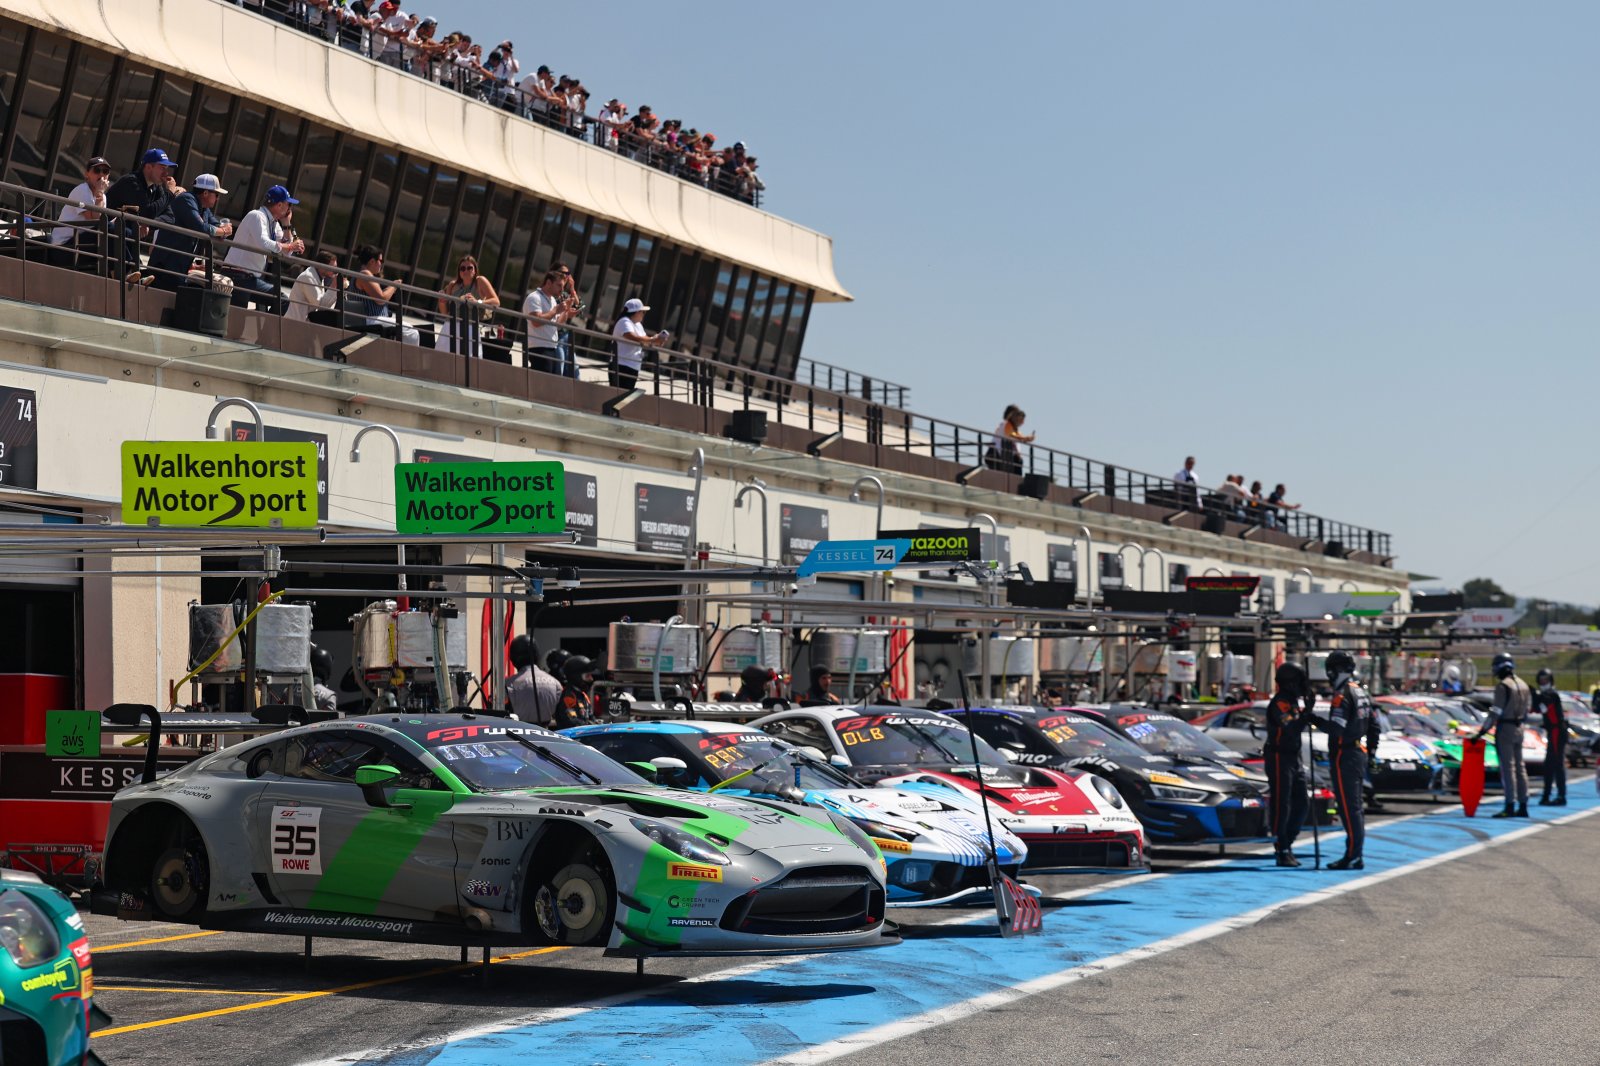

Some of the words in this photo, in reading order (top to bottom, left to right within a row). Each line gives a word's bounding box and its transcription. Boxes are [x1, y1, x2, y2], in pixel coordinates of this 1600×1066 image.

[17, 398, 33, 422] 74
[133, 453, 306, 478] Walkenhorst
[404, 471, 555, 493] Walkenhorst
[586, 481, 596, 499] 66
[133, 483, 307, 525] MotorSport
[405, 496, 556, 532] MotorSport
[576, 513, 594, 527] RACING
[910, 536, 968, 550] razoon
[817, 551, 868, 561] KESSEL
[875, 548, 894, 561] 74
[62, 735, 84, 747] aws
[273, 824, 317, 856] 35
[282, 858, 311, 870] ROWE
[671, 864, 718, 879] PIRELLI
[264, 911, 341, 926] Walkenhorst
[340, 917, 414, 935] Motorsport
